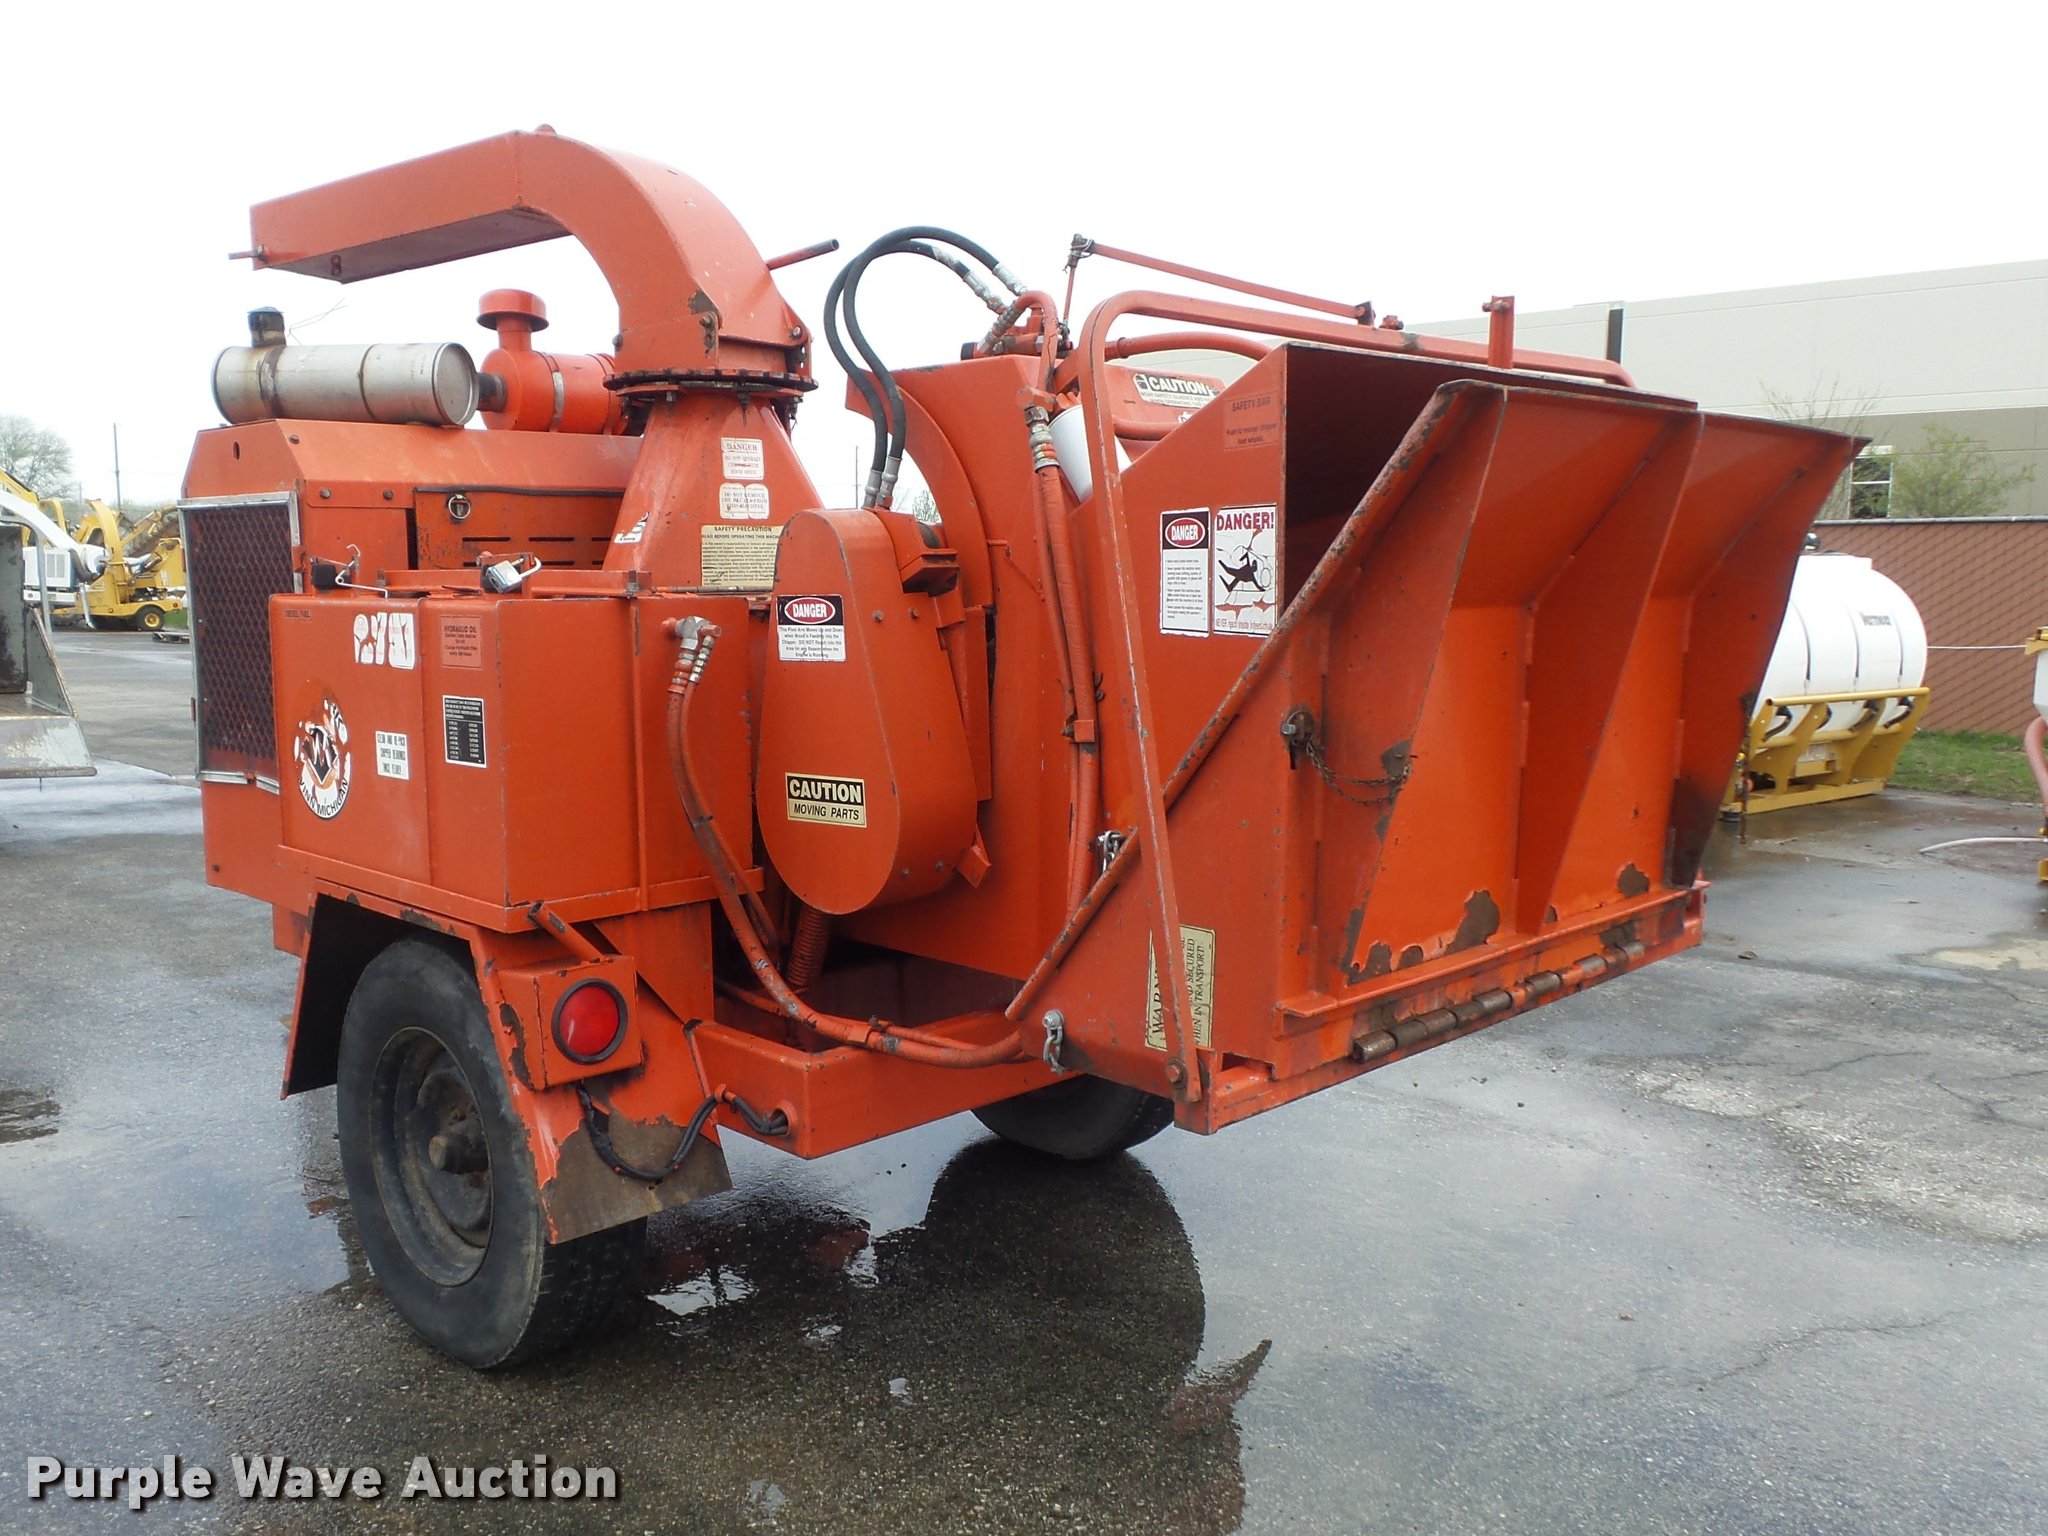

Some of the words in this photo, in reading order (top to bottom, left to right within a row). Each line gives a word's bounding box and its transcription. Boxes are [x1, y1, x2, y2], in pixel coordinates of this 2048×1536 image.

[1148, 376, 1208, 395] CAUTION
[726, 443, 758, 452] DANGER
[1216, 511, 1275, 531] DANGER!
[1171, 524, 1198, 540] DANGER
[793, 603, 828, 618] DANGER
[318, 778, 349, 816] MICHIGAN
[789, 779, 862, 804] CAUTION
[793, 803, 827, 817] MOVING
[830, 807, 860, 821] PARTS
[1186, 938, 1195, 983] SECURED
[1194, 1005, 1202, 1018] IN
